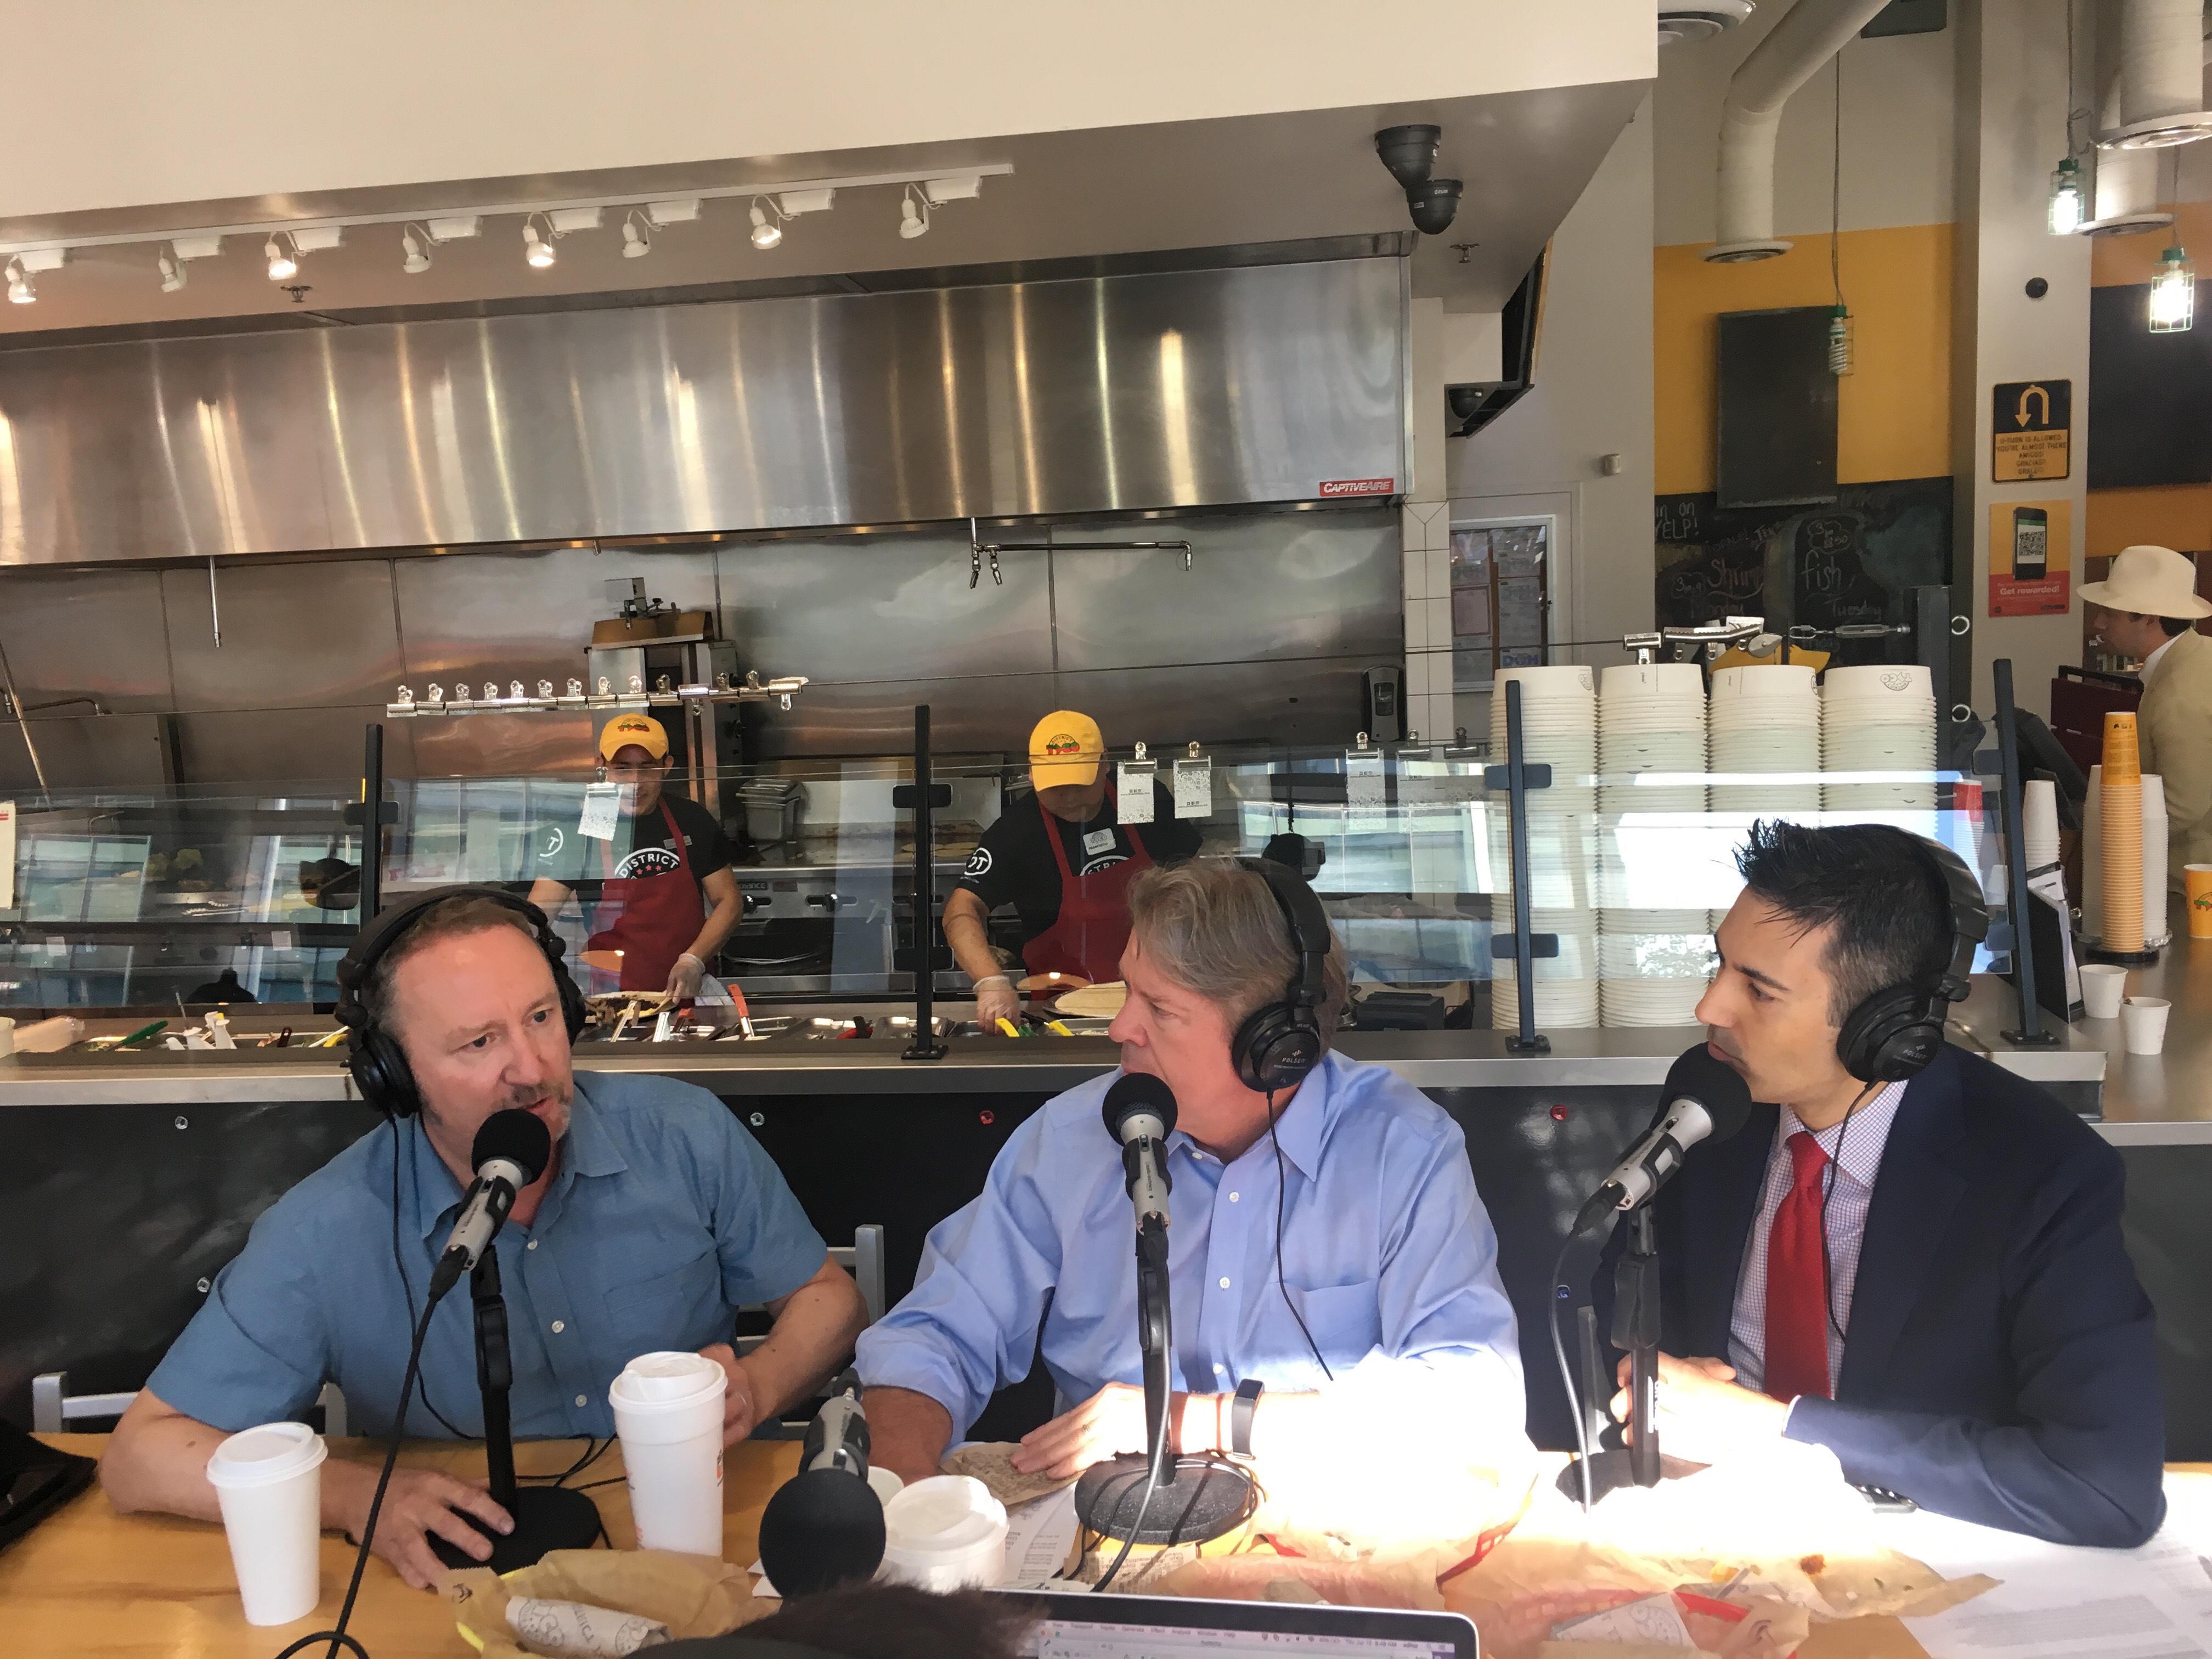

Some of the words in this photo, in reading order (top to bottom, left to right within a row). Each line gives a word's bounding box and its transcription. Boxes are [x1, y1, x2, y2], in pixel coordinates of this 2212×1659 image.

[2000, 587, 2015, 595] Get
[2017, 585, 2059, 594] rewarded!
[619, 853, 679, 878] DISTRICT
